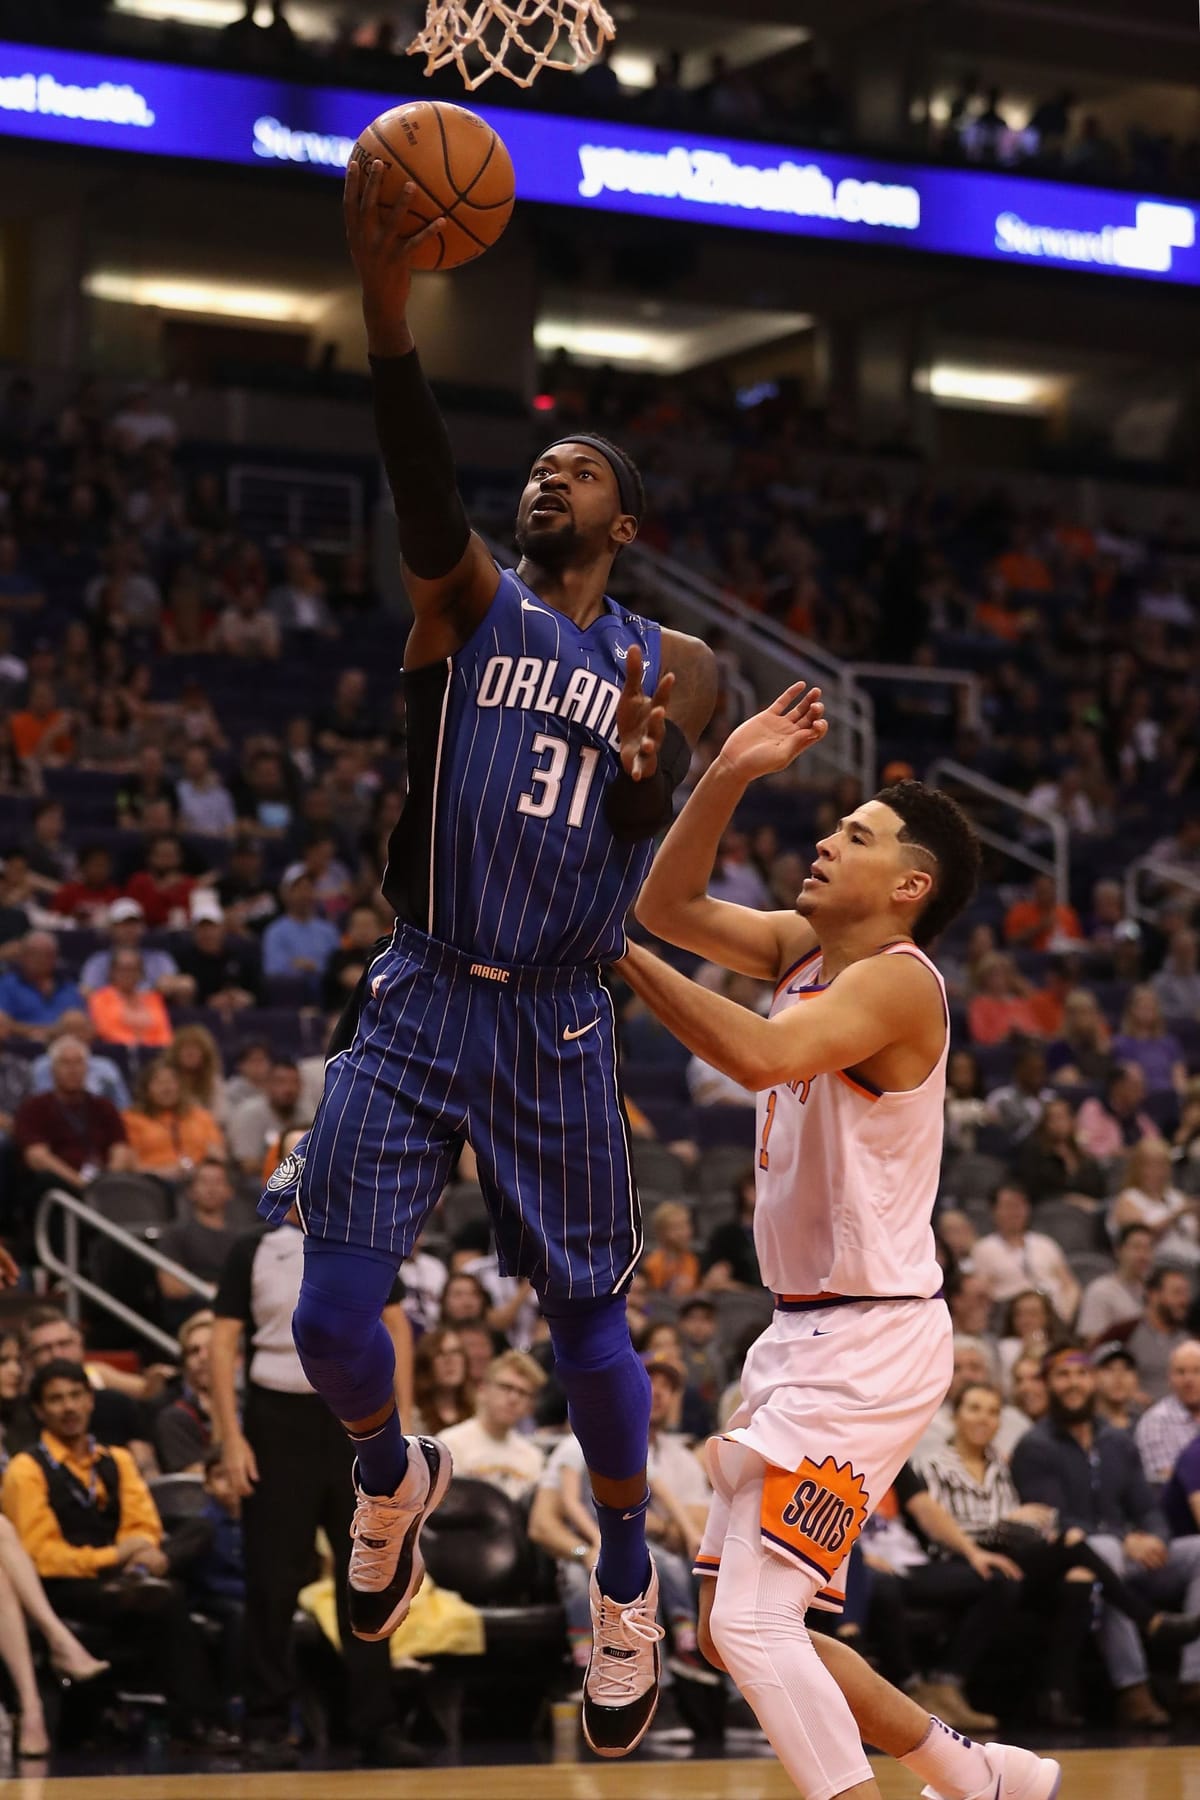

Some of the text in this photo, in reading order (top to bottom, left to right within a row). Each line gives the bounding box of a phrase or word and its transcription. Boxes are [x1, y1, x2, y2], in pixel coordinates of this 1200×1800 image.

[476, 655, 622, 752] ORLAN
[516, 732, 601, 828] 31
[470, 963, 510, 983] MAGIC
[759, 1090, 777, 1172] 1
